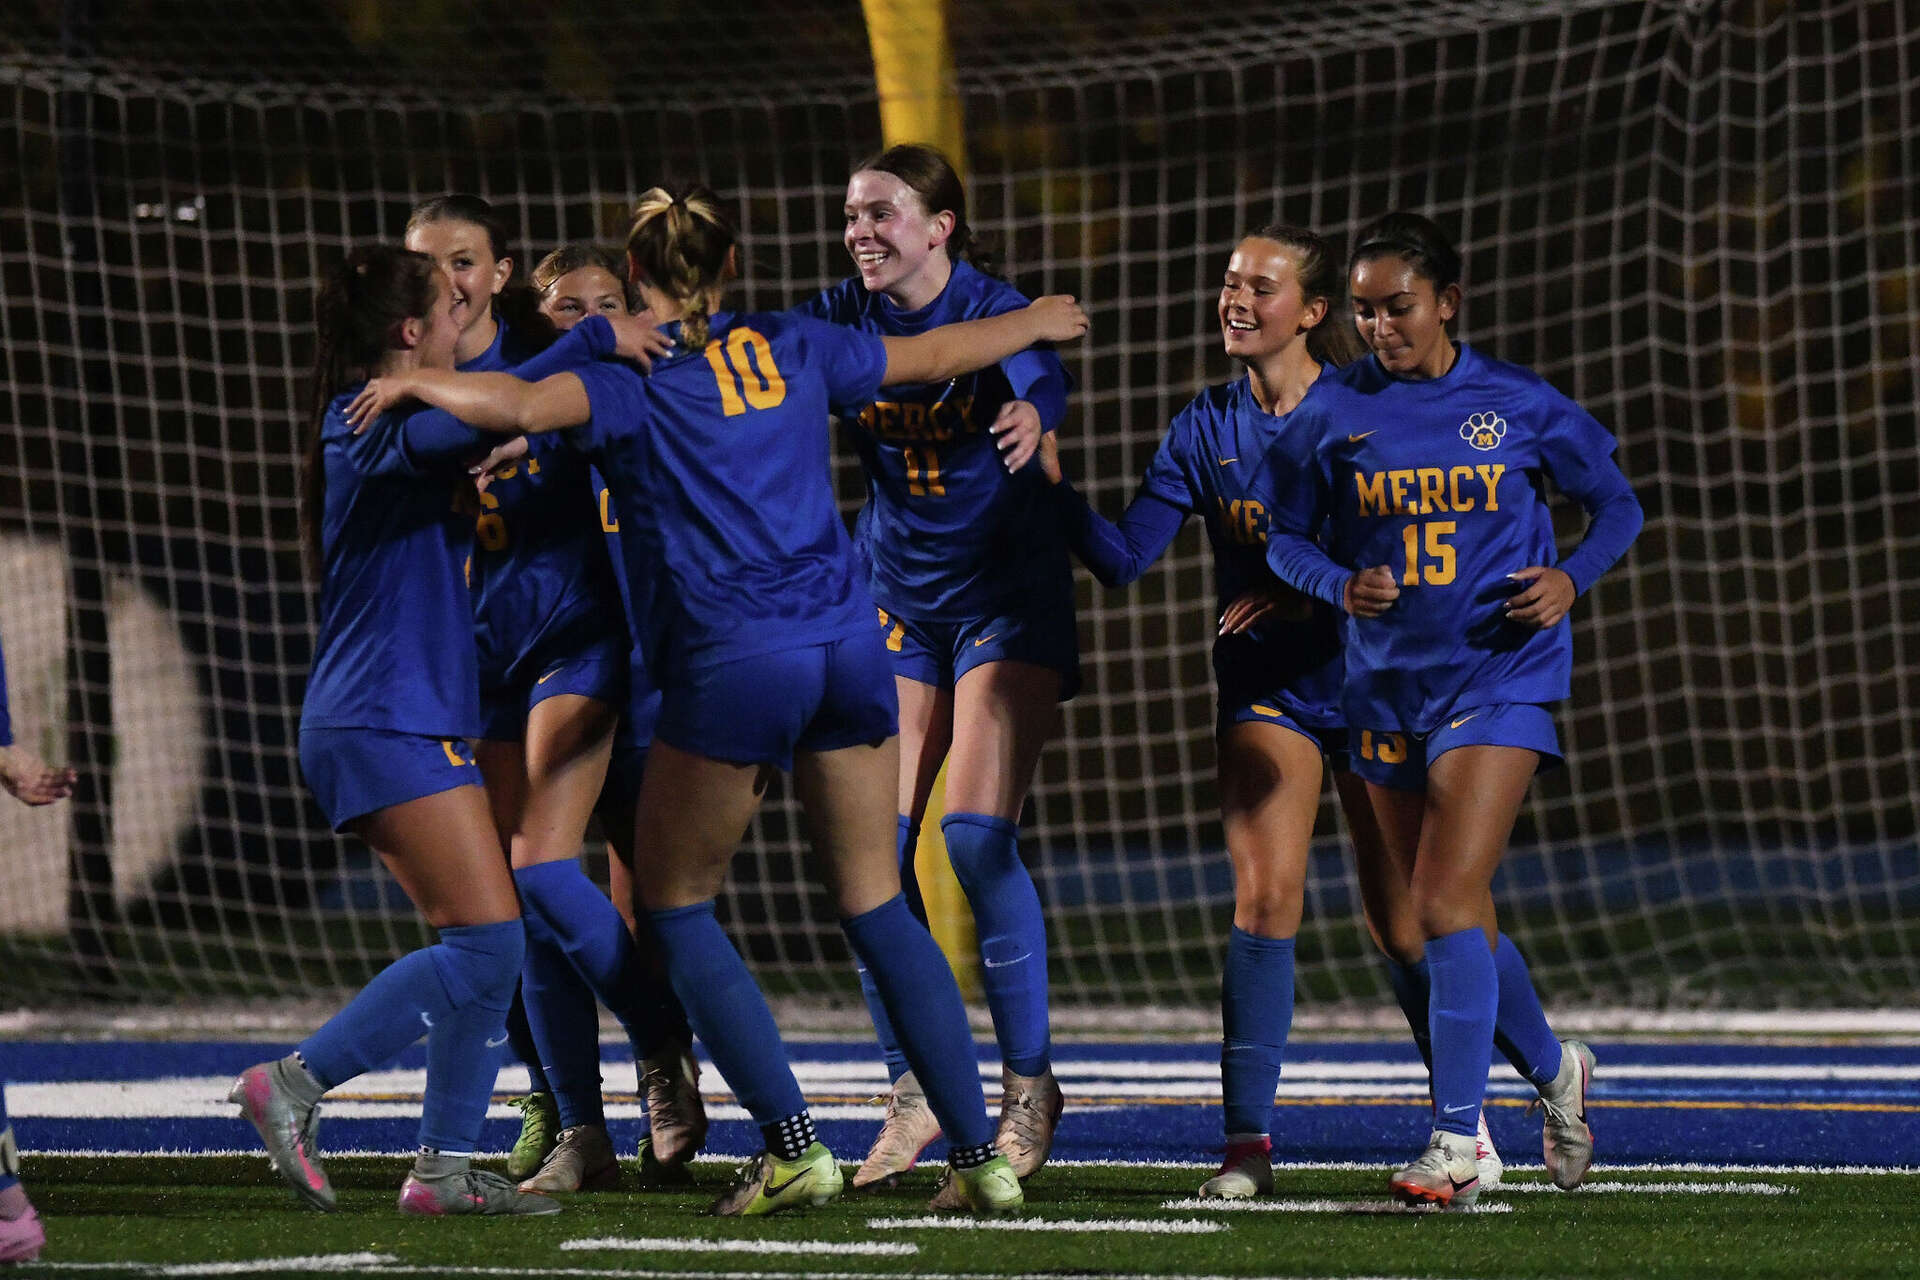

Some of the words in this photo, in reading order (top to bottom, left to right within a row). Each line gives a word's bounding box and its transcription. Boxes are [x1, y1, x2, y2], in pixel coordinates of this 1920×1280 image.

[704, 326, 787, 417] 10
[1476, 432, 1494, 446] M
[904, 446, 946, 497] 11
[1355, 464, 1505, 517] MERCY
[1402, 521, 1456, 586] 15
